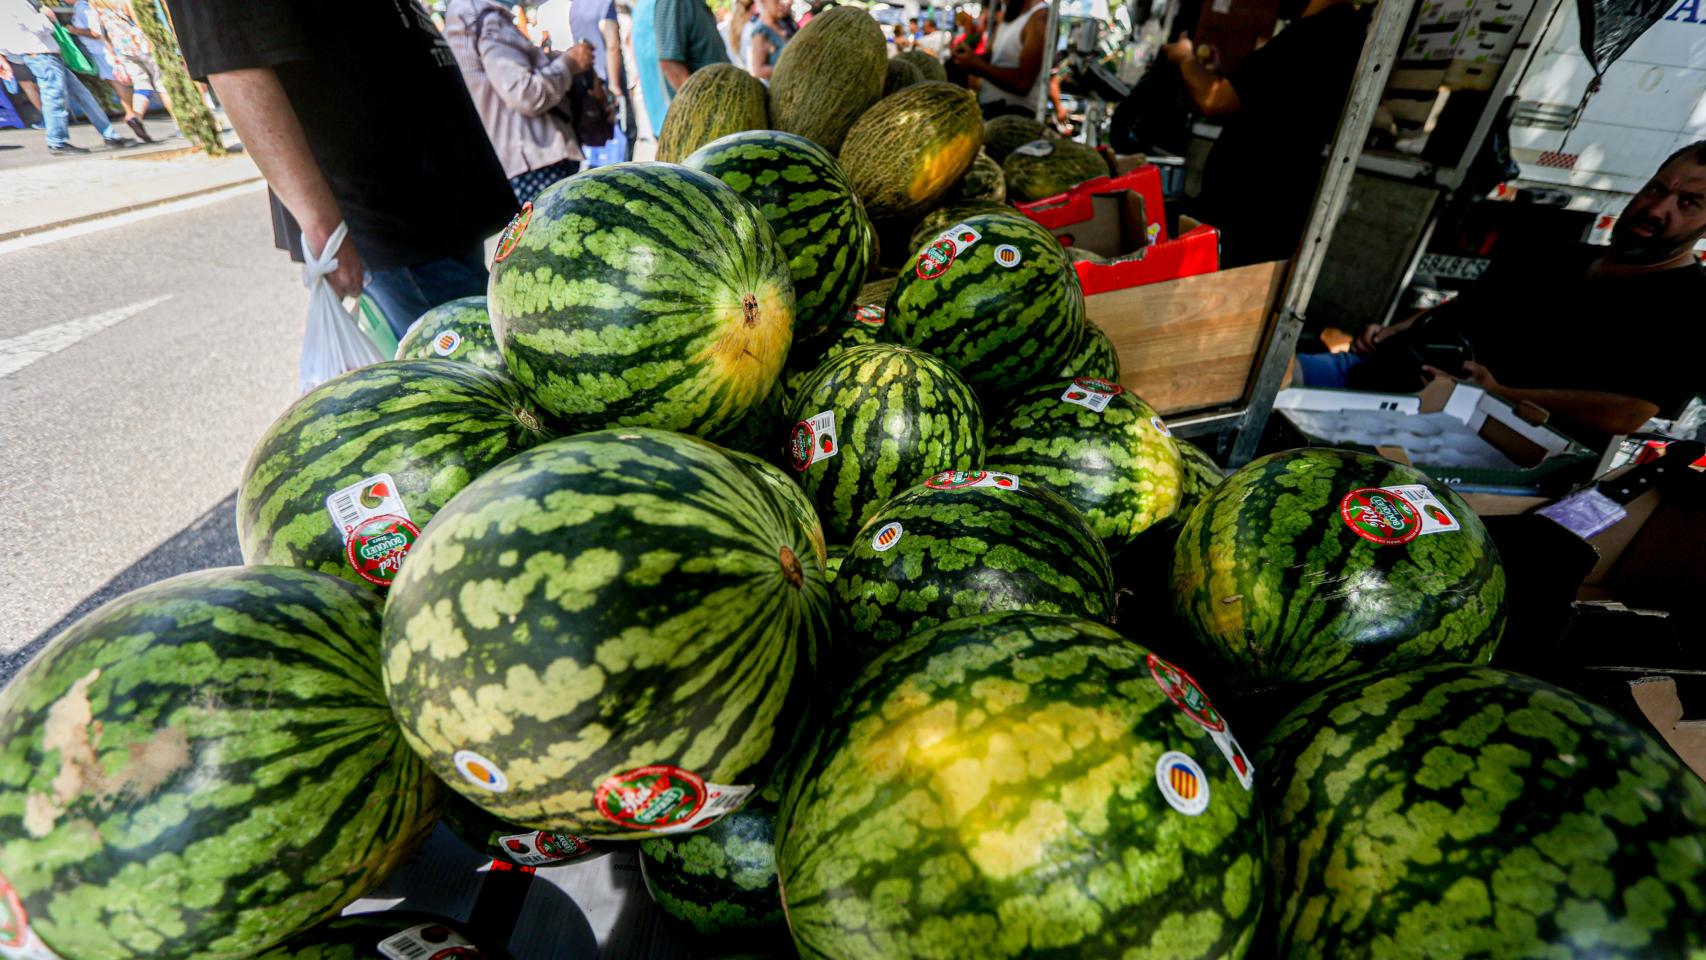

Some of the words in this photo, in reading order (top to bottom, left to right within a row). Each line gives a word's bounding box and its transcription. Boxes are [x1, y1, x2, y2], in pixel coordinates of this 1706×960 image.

[1374, 499, 1401, 527] BOUQUET
[366, 536, 404, 556] BOUQUET
[379, 550, 408, 577] Red
